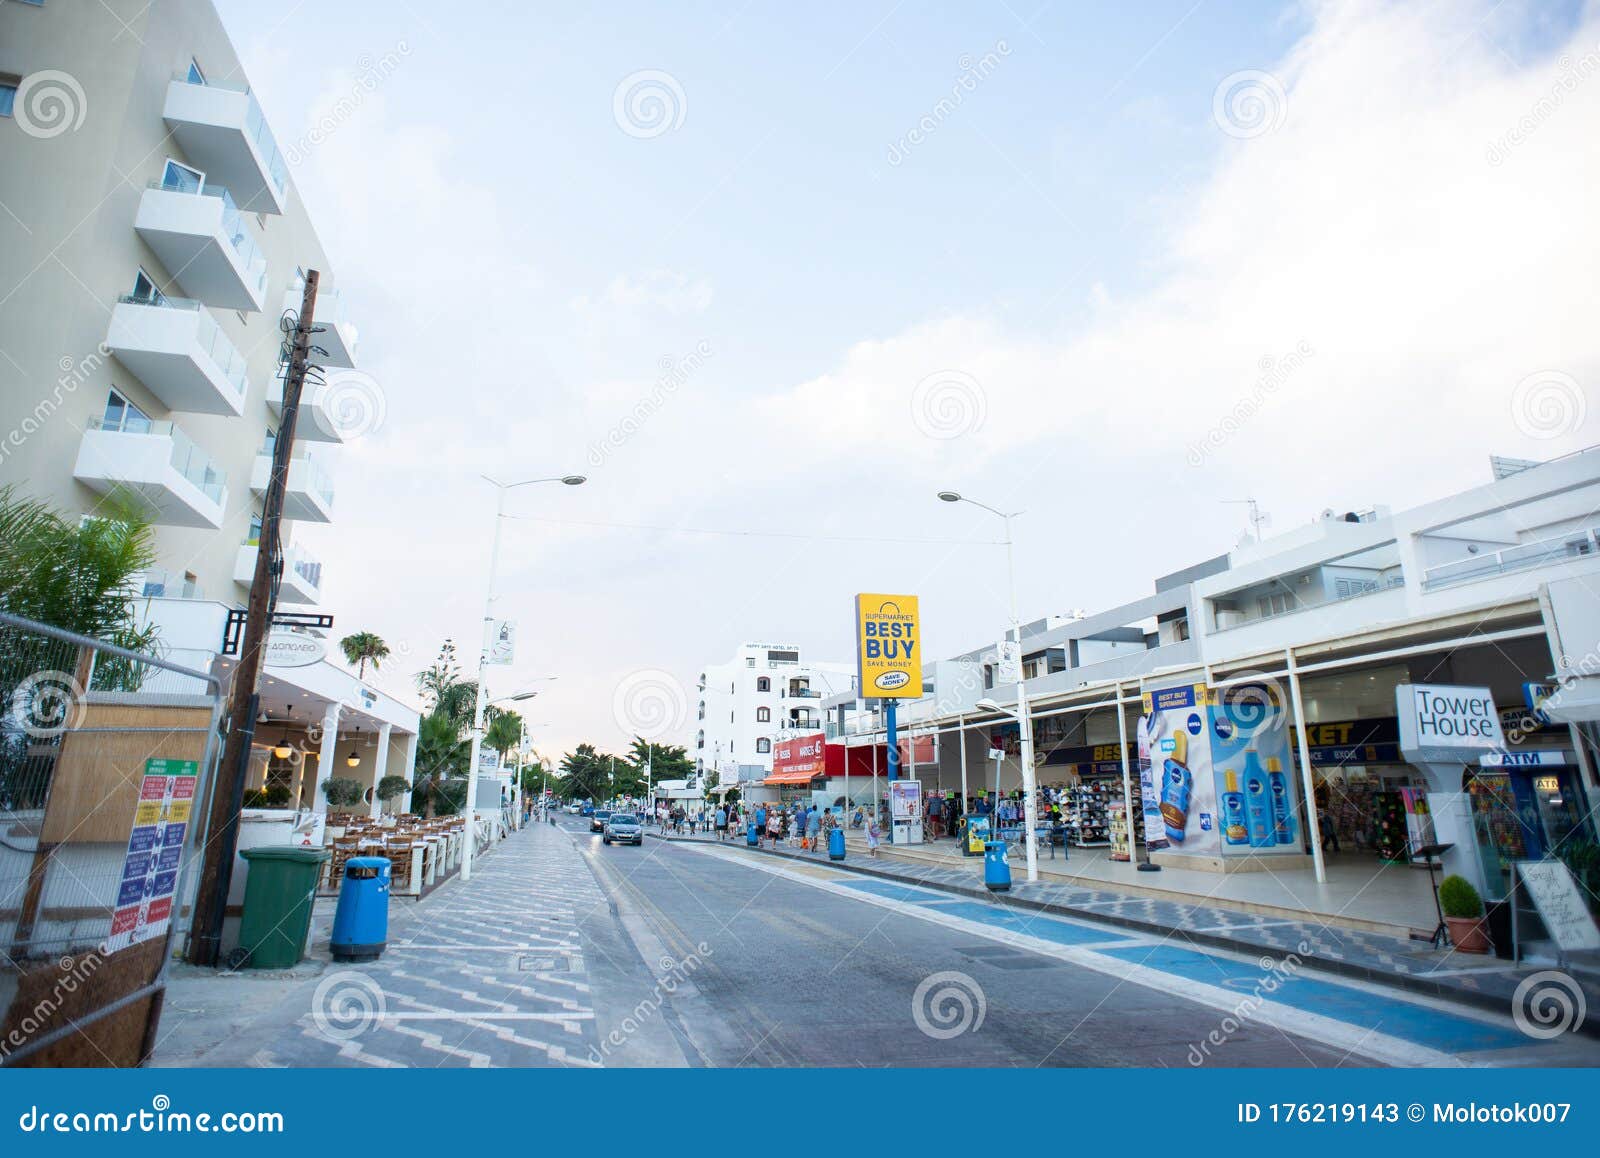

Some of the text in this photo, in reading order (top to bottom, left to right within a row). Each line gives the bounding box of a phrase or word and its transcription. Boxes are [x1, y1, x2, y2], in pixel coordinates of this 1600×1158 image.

[866, 612, 914, 621] SUPERMARKET
[865, 621, 915, 638] BEST
[866, 639, 915, 659] BUY
[884, 673, 901, 681] SAVE
[1158, 693, 1173, 701] BEST
[1416, 690, 1491, 717] Tower
[1420, 711, 1493, 737] House
[1502, 753, 1541, 765] ATM
